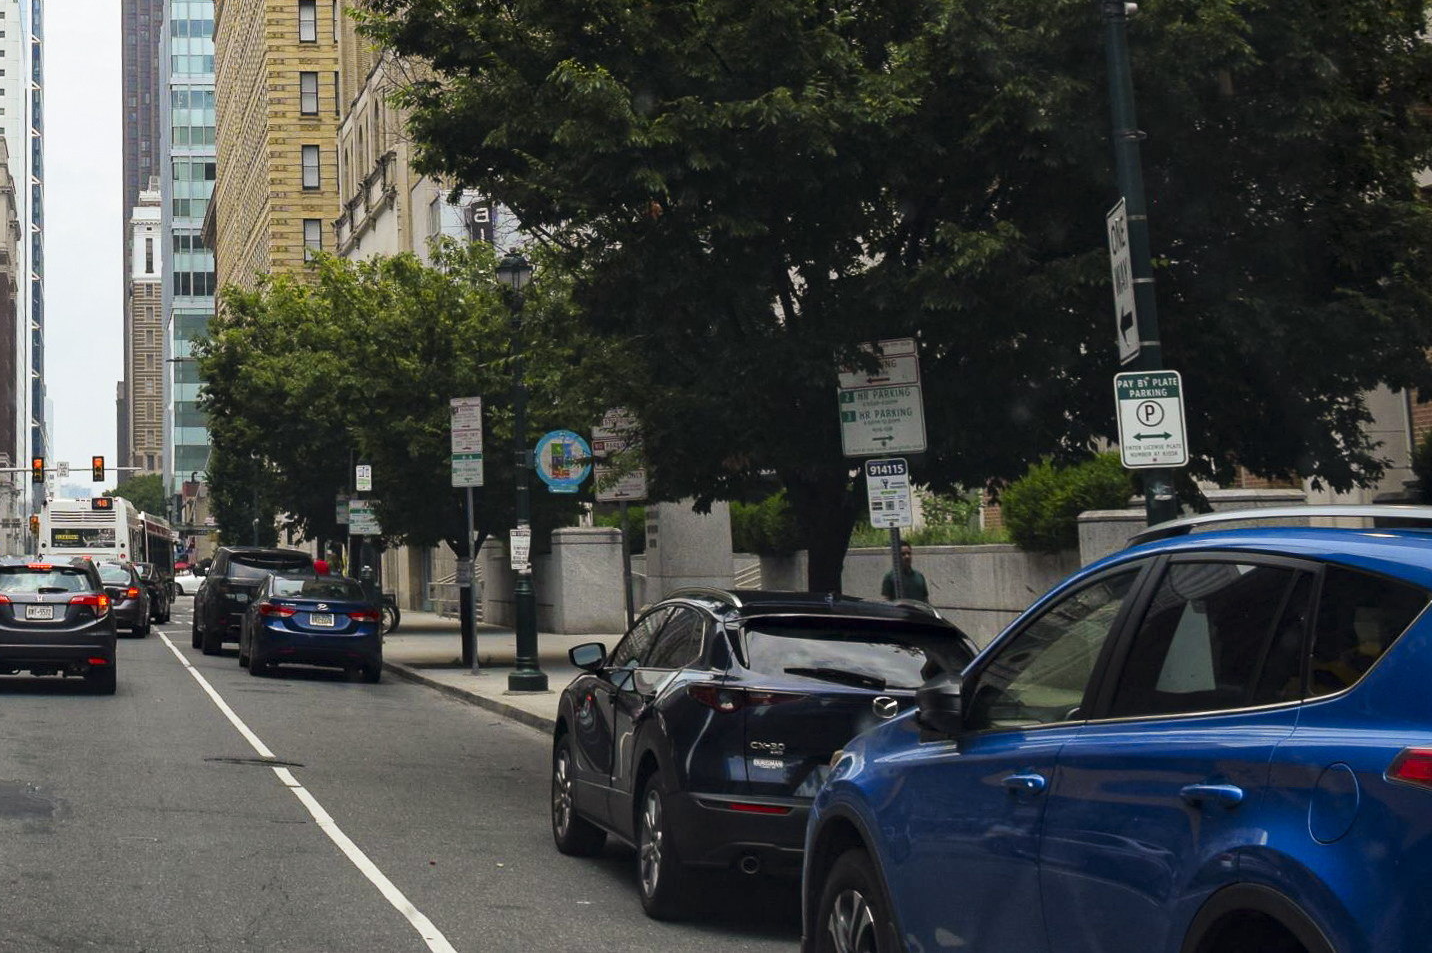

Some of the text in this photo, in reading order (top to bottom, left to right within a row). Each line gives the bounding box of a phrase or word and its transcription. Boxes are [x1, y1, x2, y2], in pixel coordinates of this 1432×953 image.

[1110, 215, 1126, 256] ONE
[1114, 256, 1129, 296] WAY
[1117, 377, 1177, 388] PAY BY PLATE
[872, 387, 911, 399] PARKING
[1129, 388, 1168, 398] PARKING
[859, 411, 871, 421] HR
[874, 407, 913, 419] PARKING
[1144, 404, 1155, 422] P
[869, 463, 905, 476] 914115
[750, 741, 786, 751] CX-30
